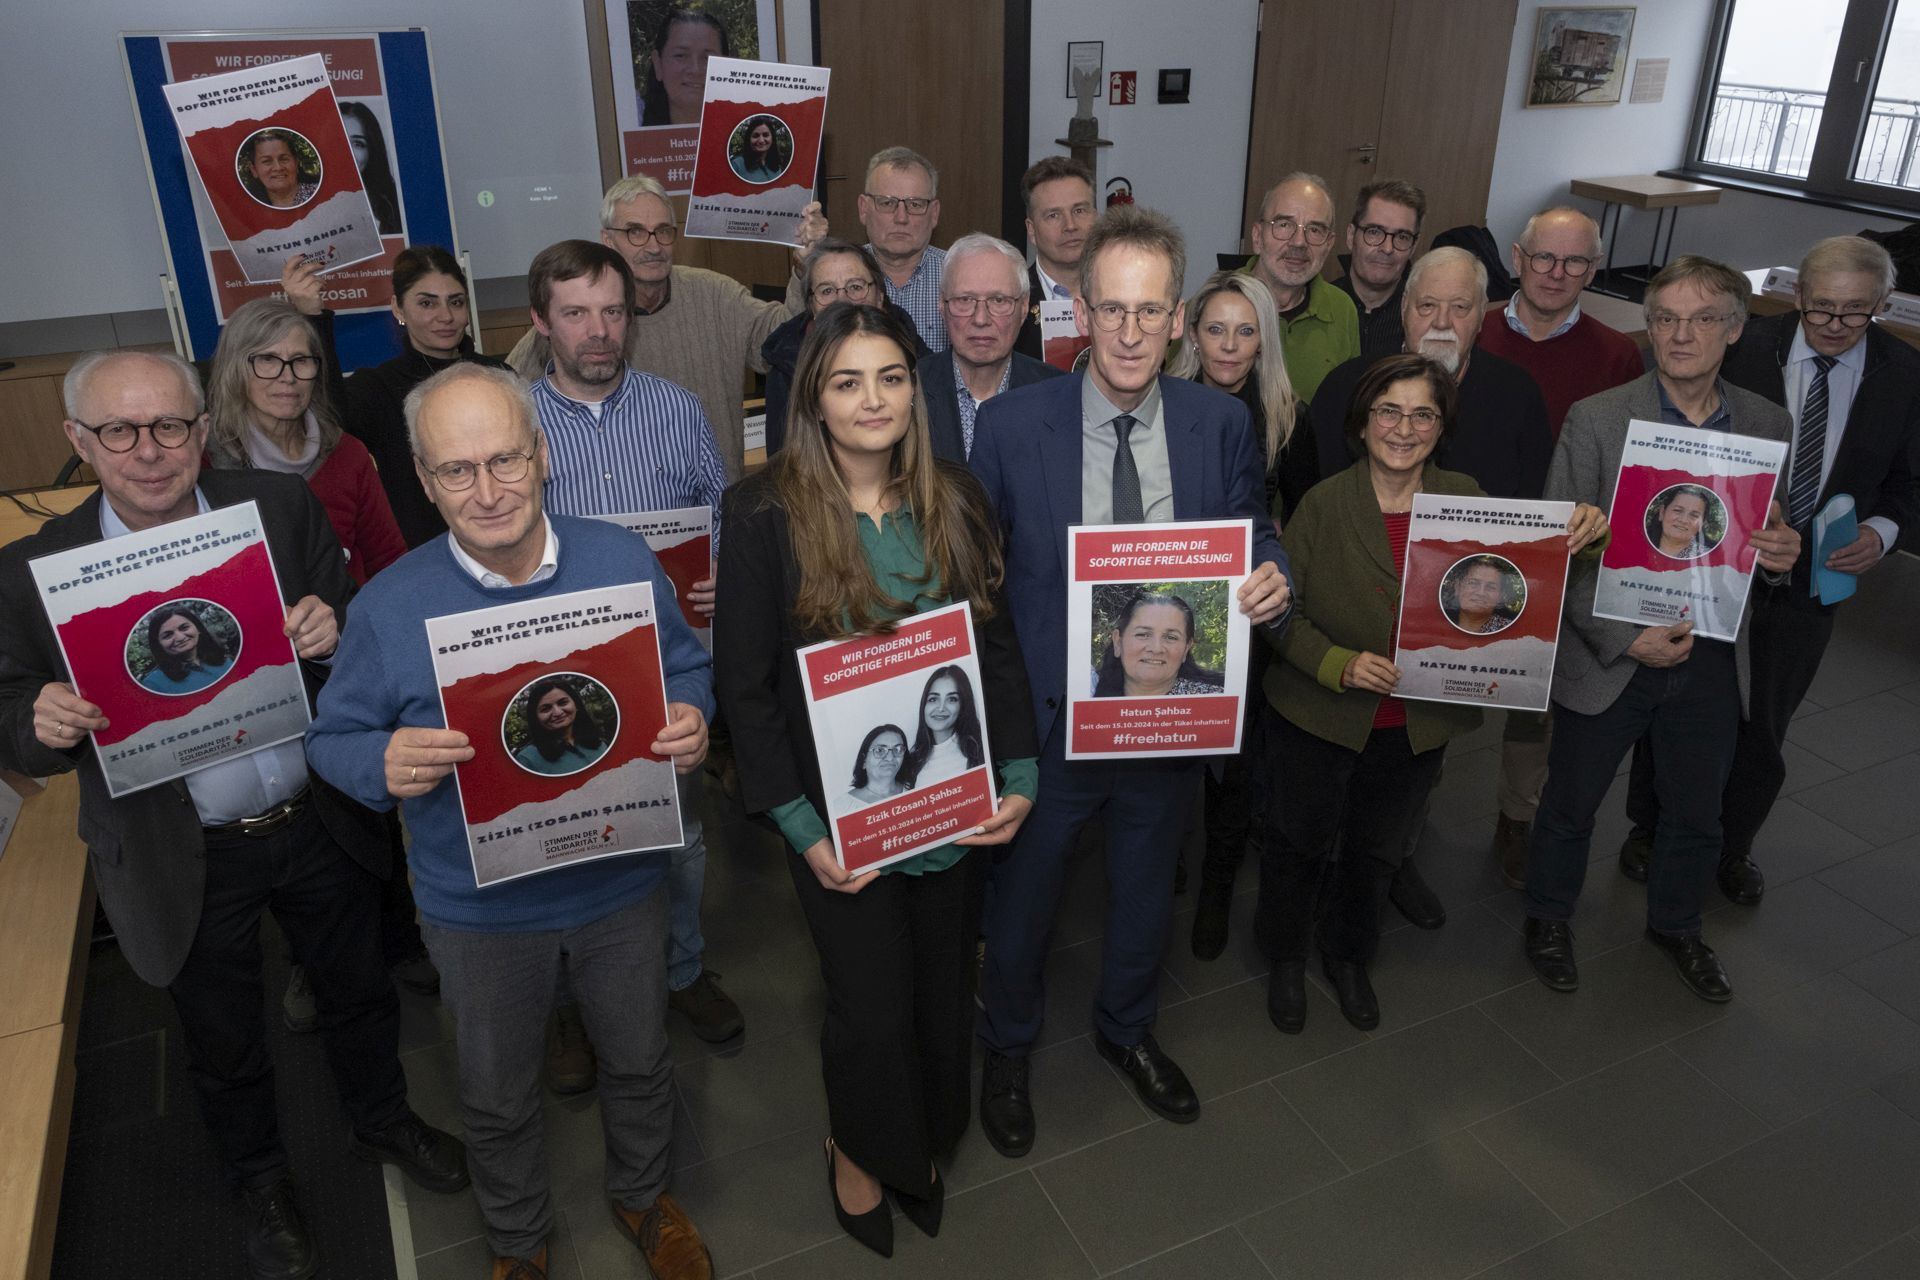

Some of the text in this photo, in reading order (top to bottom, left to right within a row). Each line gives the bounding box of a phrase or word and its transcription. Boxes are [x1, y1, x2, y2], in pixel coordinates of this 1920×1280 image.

[216, 54, 306, 67] WIR FORD
[198, 73, 298, 100] WIR FORDERN DIE
[710, 76, 825, 91] SOFORTIGE FREILASSUNG!
[750, 73, 791, 82] FORDERN
[177, 95, 243, 113] SOFORTIGE
[245, 75, 324, 99] FREILASSUNG!
[664, 153, 697, 162] 15.10.202
[256, 241, 301, 255] HATUN
[304, 224, 354, 246] ŞAHBAZ
[1631, 440, 1776, 468] SOFORTIGE FREILASSUNG!
[1655, 436, 1676, 444] WIR
[1733, 449, 1752, 457] DIE
[1416, 513, 1566, 529] SOFORTIGE FREILASSUNG
[1466, 510, 1522, 518] FORDERN
[626, 523, 658, 531] DERN
[641, 525, 707, 537] ILASSUNG!
[80, 529, 221, 575] WIR FORDERN DIE
[1112, 540, 1209, 553] WIR FORDERN DIE
[48, 529, 257, 594] SOFORTIGE FREILASSUNG!
[1089, 553, 1232, 568] SOFORTIGE FREILASSUNG!
[1620, 580, 1663, 593] HATUN
[471, 605, 613, 639] WIR FORDERN DIE
[438, 610, 649, 654] SOFORTIGE FREILASSUNG!
[841, 630, 932, 664] WIR FORDERN DIE
[823, 636, 957, 684] SOFORTIGE FREILASSUNG!
[1420, 661, 1527, 676] HATUN ŞAHBAZ
[160, 718, 230, 746] (ZOSAN)
[233, 695, 299, 722] ŞAHBAZ
[1120, 707, 1192, 718] Hatun Şahbaz
[1095, 722, 1111, 730] dem
[1112, 721, 1151, 729] 15.10.2024
[1193, 718, 1230, 726] inhaftiert!
[177, 741, 215, 757] STIMMEN
[216, 735, 231, 745] DER
[1113, 732, 1197, 745] #freehatun
[528, 809, 598, 831] (ZOSAN)
[602, 798, 671, 816] ŞAHBAZ
[866, 785, 963, 825] Zizik (Zosan) Şahbaz
[848, 838, 862, 847] Seit
[862, 833, 877, 842] dem
[878, 819, 915, 836] 15.10.2024
[922, 812, 933, 821] der
[952, 793, 985, 810] inhaftiert!
[544, 829, 598, 847] STIMMEN DER
[881, 817, 959, 851] #freezosan
[545, 837, 598, 854] SOLIDARITÄT
